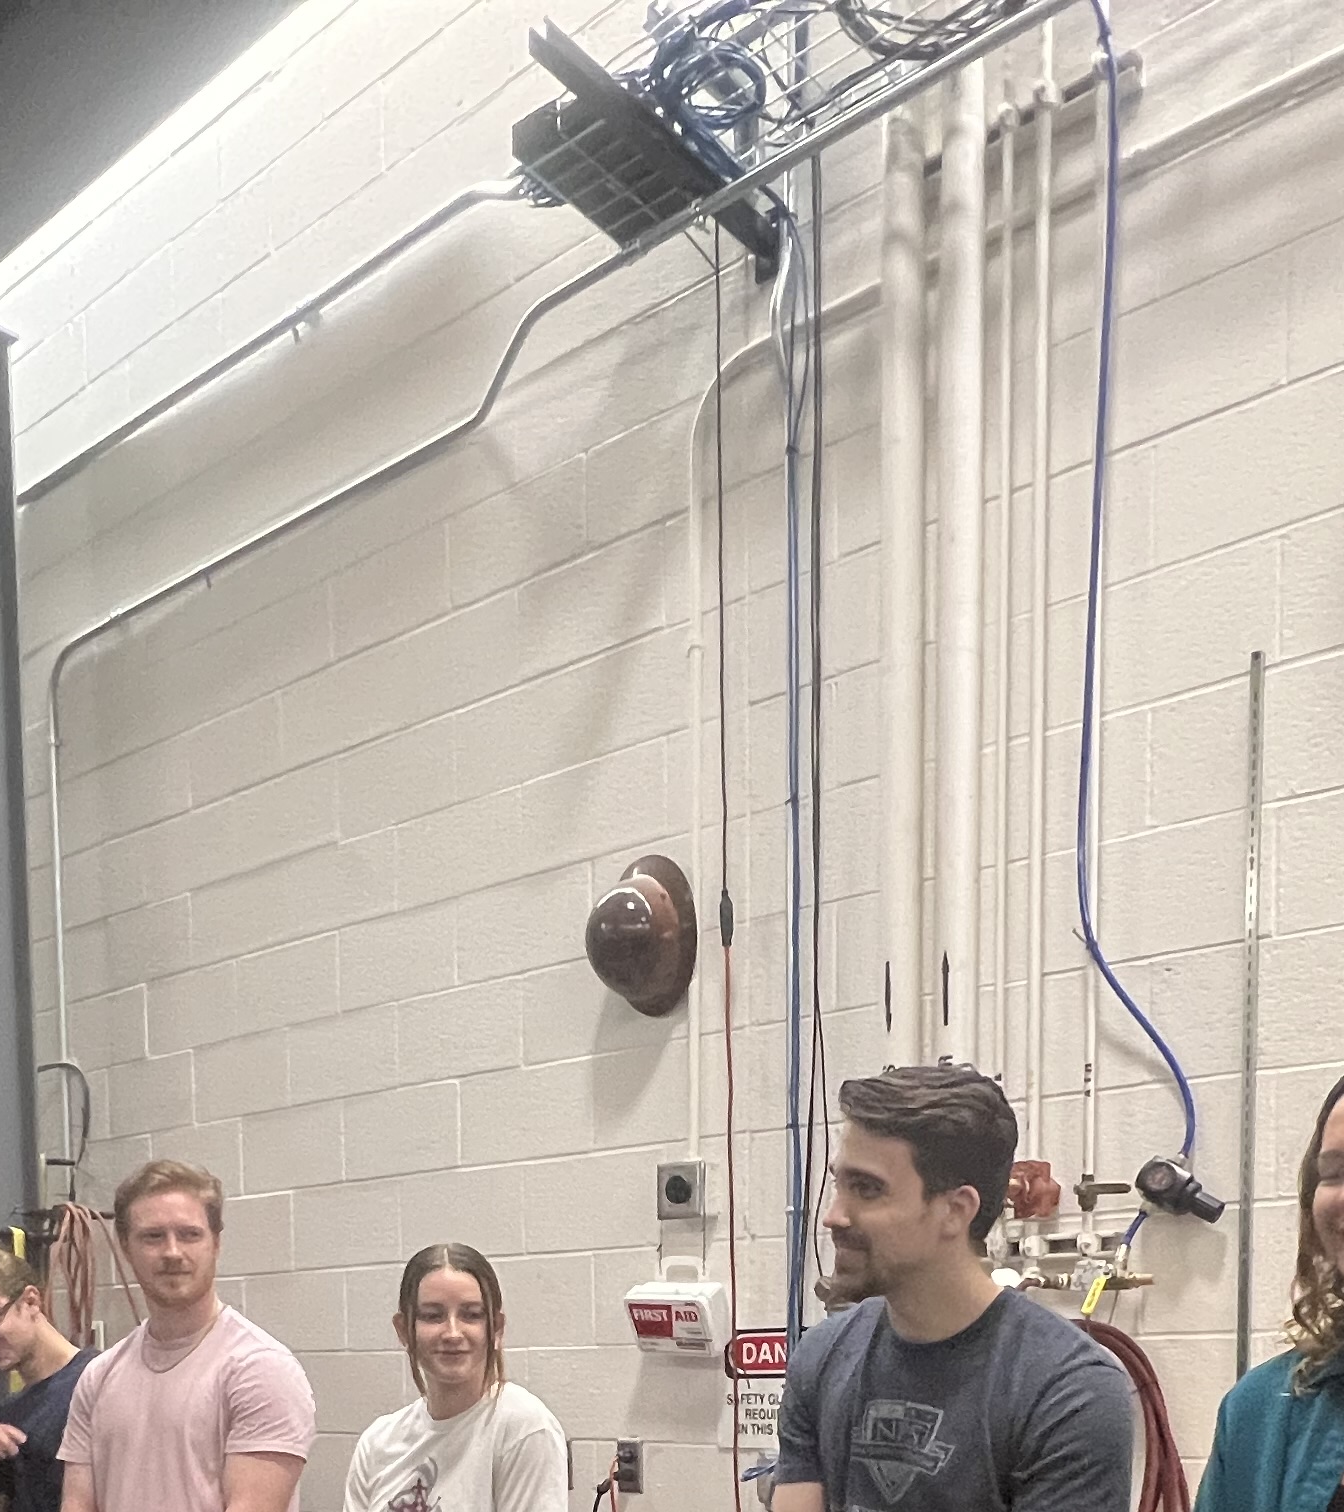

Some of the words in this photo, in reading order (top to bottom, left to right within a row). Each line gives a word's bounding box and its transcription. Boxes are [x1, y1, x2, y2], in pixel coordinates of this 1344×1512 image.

[632, 1308, 668, 1322] FIRST
[675, 1310, 698, 1322] AID
[726, 1393, 766, 1405] SFETY
[750, 1423, 774, 1435] THIS
